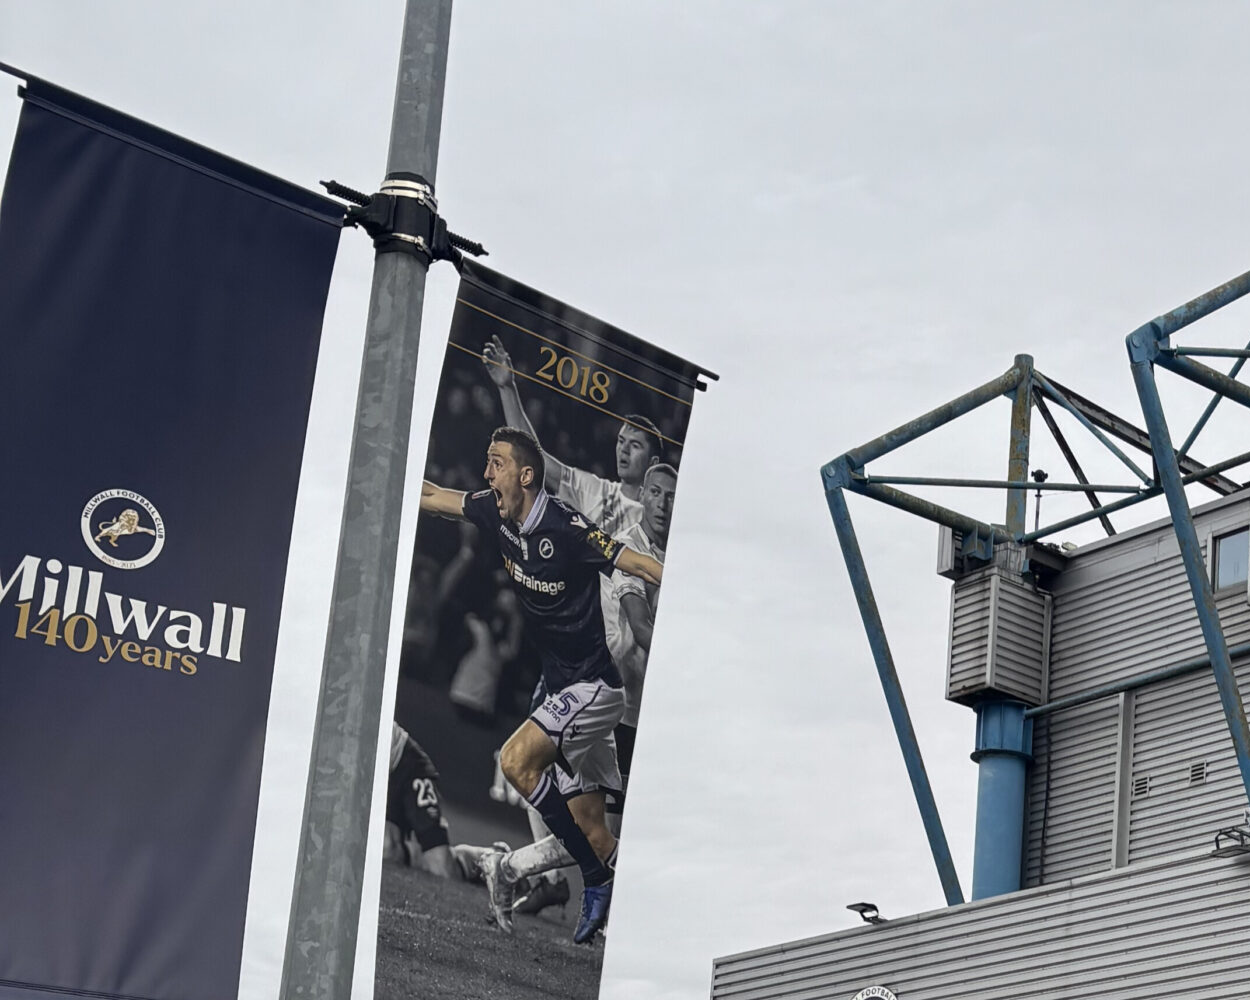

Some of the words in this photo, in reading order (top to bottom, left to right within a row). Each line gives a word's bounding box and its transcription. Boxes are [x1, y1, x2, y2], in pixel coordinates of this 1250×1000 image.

[535, 345, 611, 404] 2018
[83, 491, 115, 519] MILLWALL
[117, 490, 157, 516] FOOTBALL
[154, 517, 164, 539] CLUB
[14, 602, 98, 653] 140
[99, 634, 198, 676] years
[413, 778, 437, 807] 23
